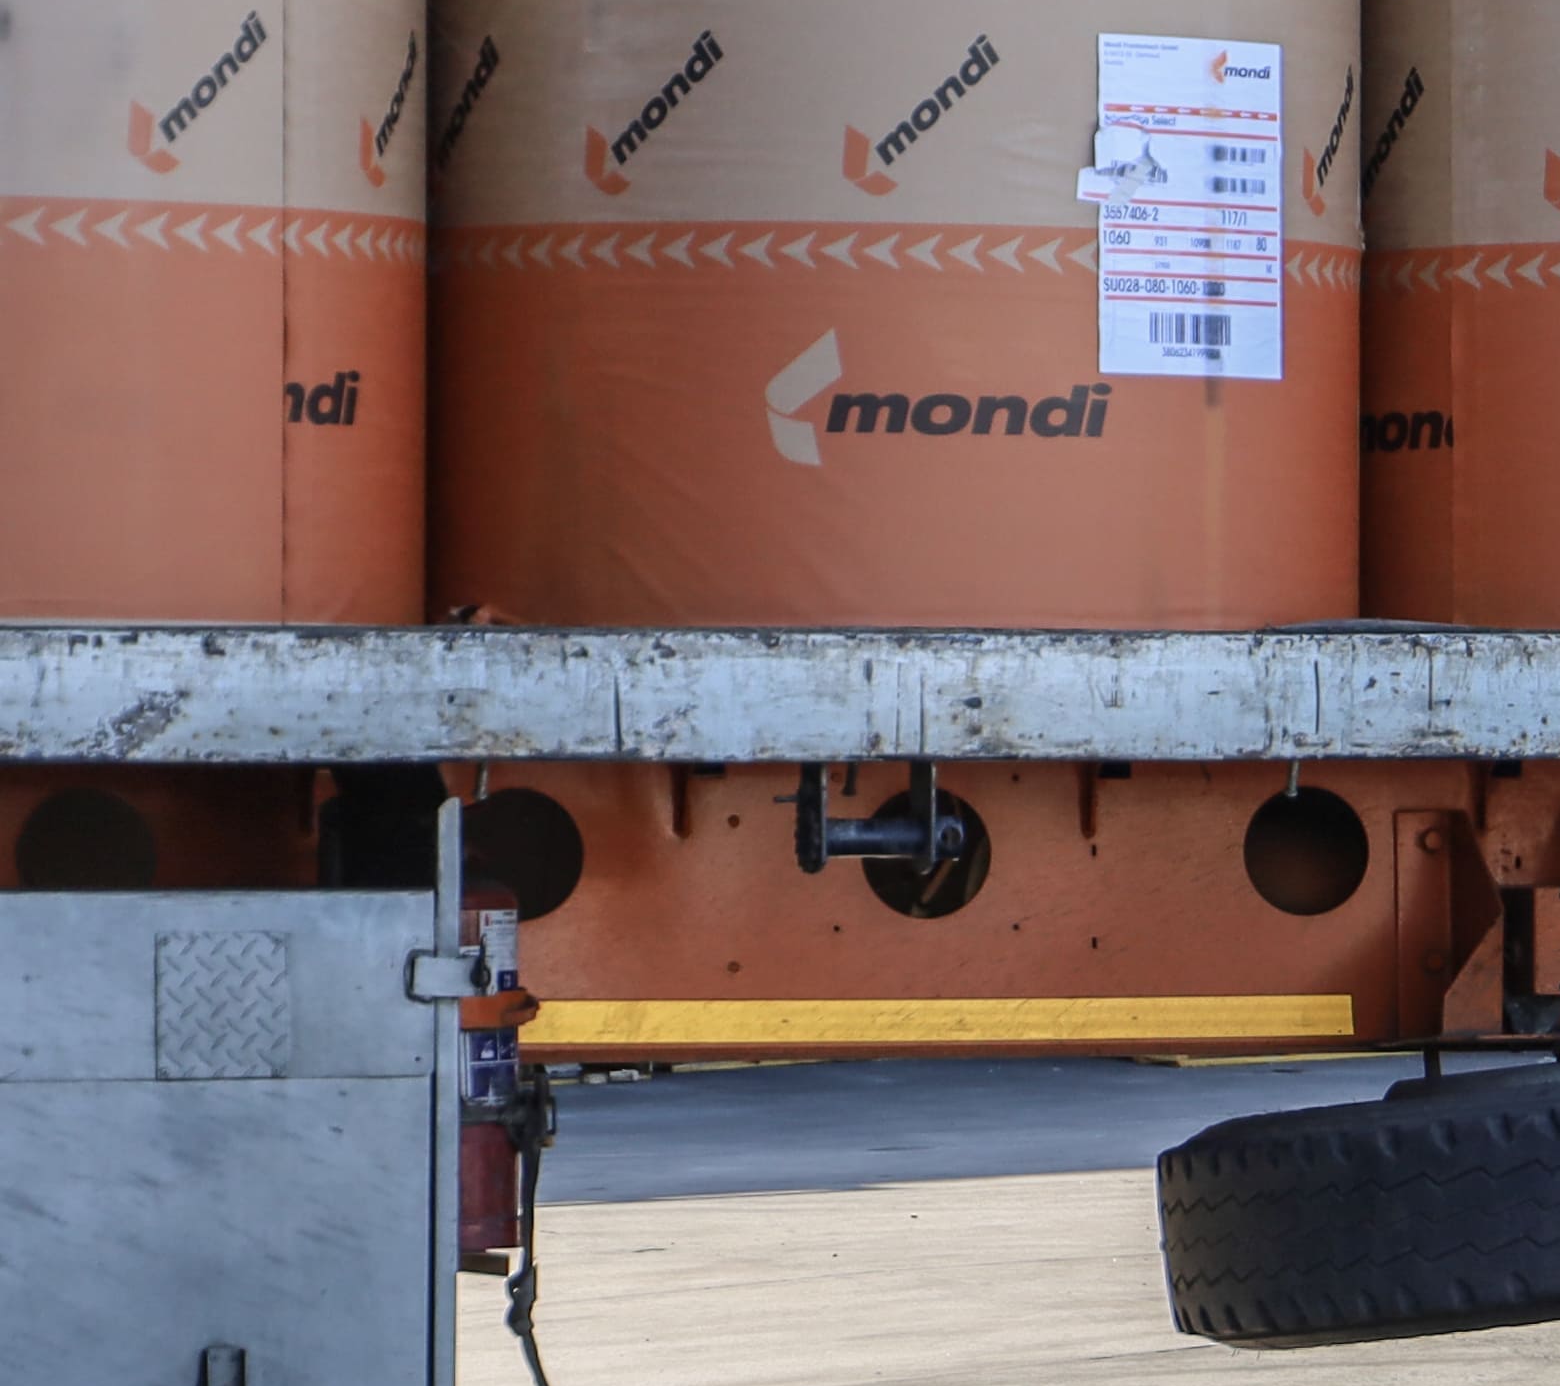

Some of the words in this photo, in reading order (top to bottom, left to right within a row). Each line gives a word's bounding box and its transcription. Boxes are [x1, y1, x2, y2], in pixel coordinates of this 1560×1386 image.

[160, 11, 266, 142] mondi
[1224, 65, 1271, 80] mondi
[611, 31, 723, 165] mondi
[876, 35, 999, 165] mondi
[1103, 205, 1159, 221] 3557406-2
[1103, 230, 1131, 245] 1060
[1103, 276, 1226, 298] SU028-080-1060-10
[825, 384, 1110, 437] mondi
